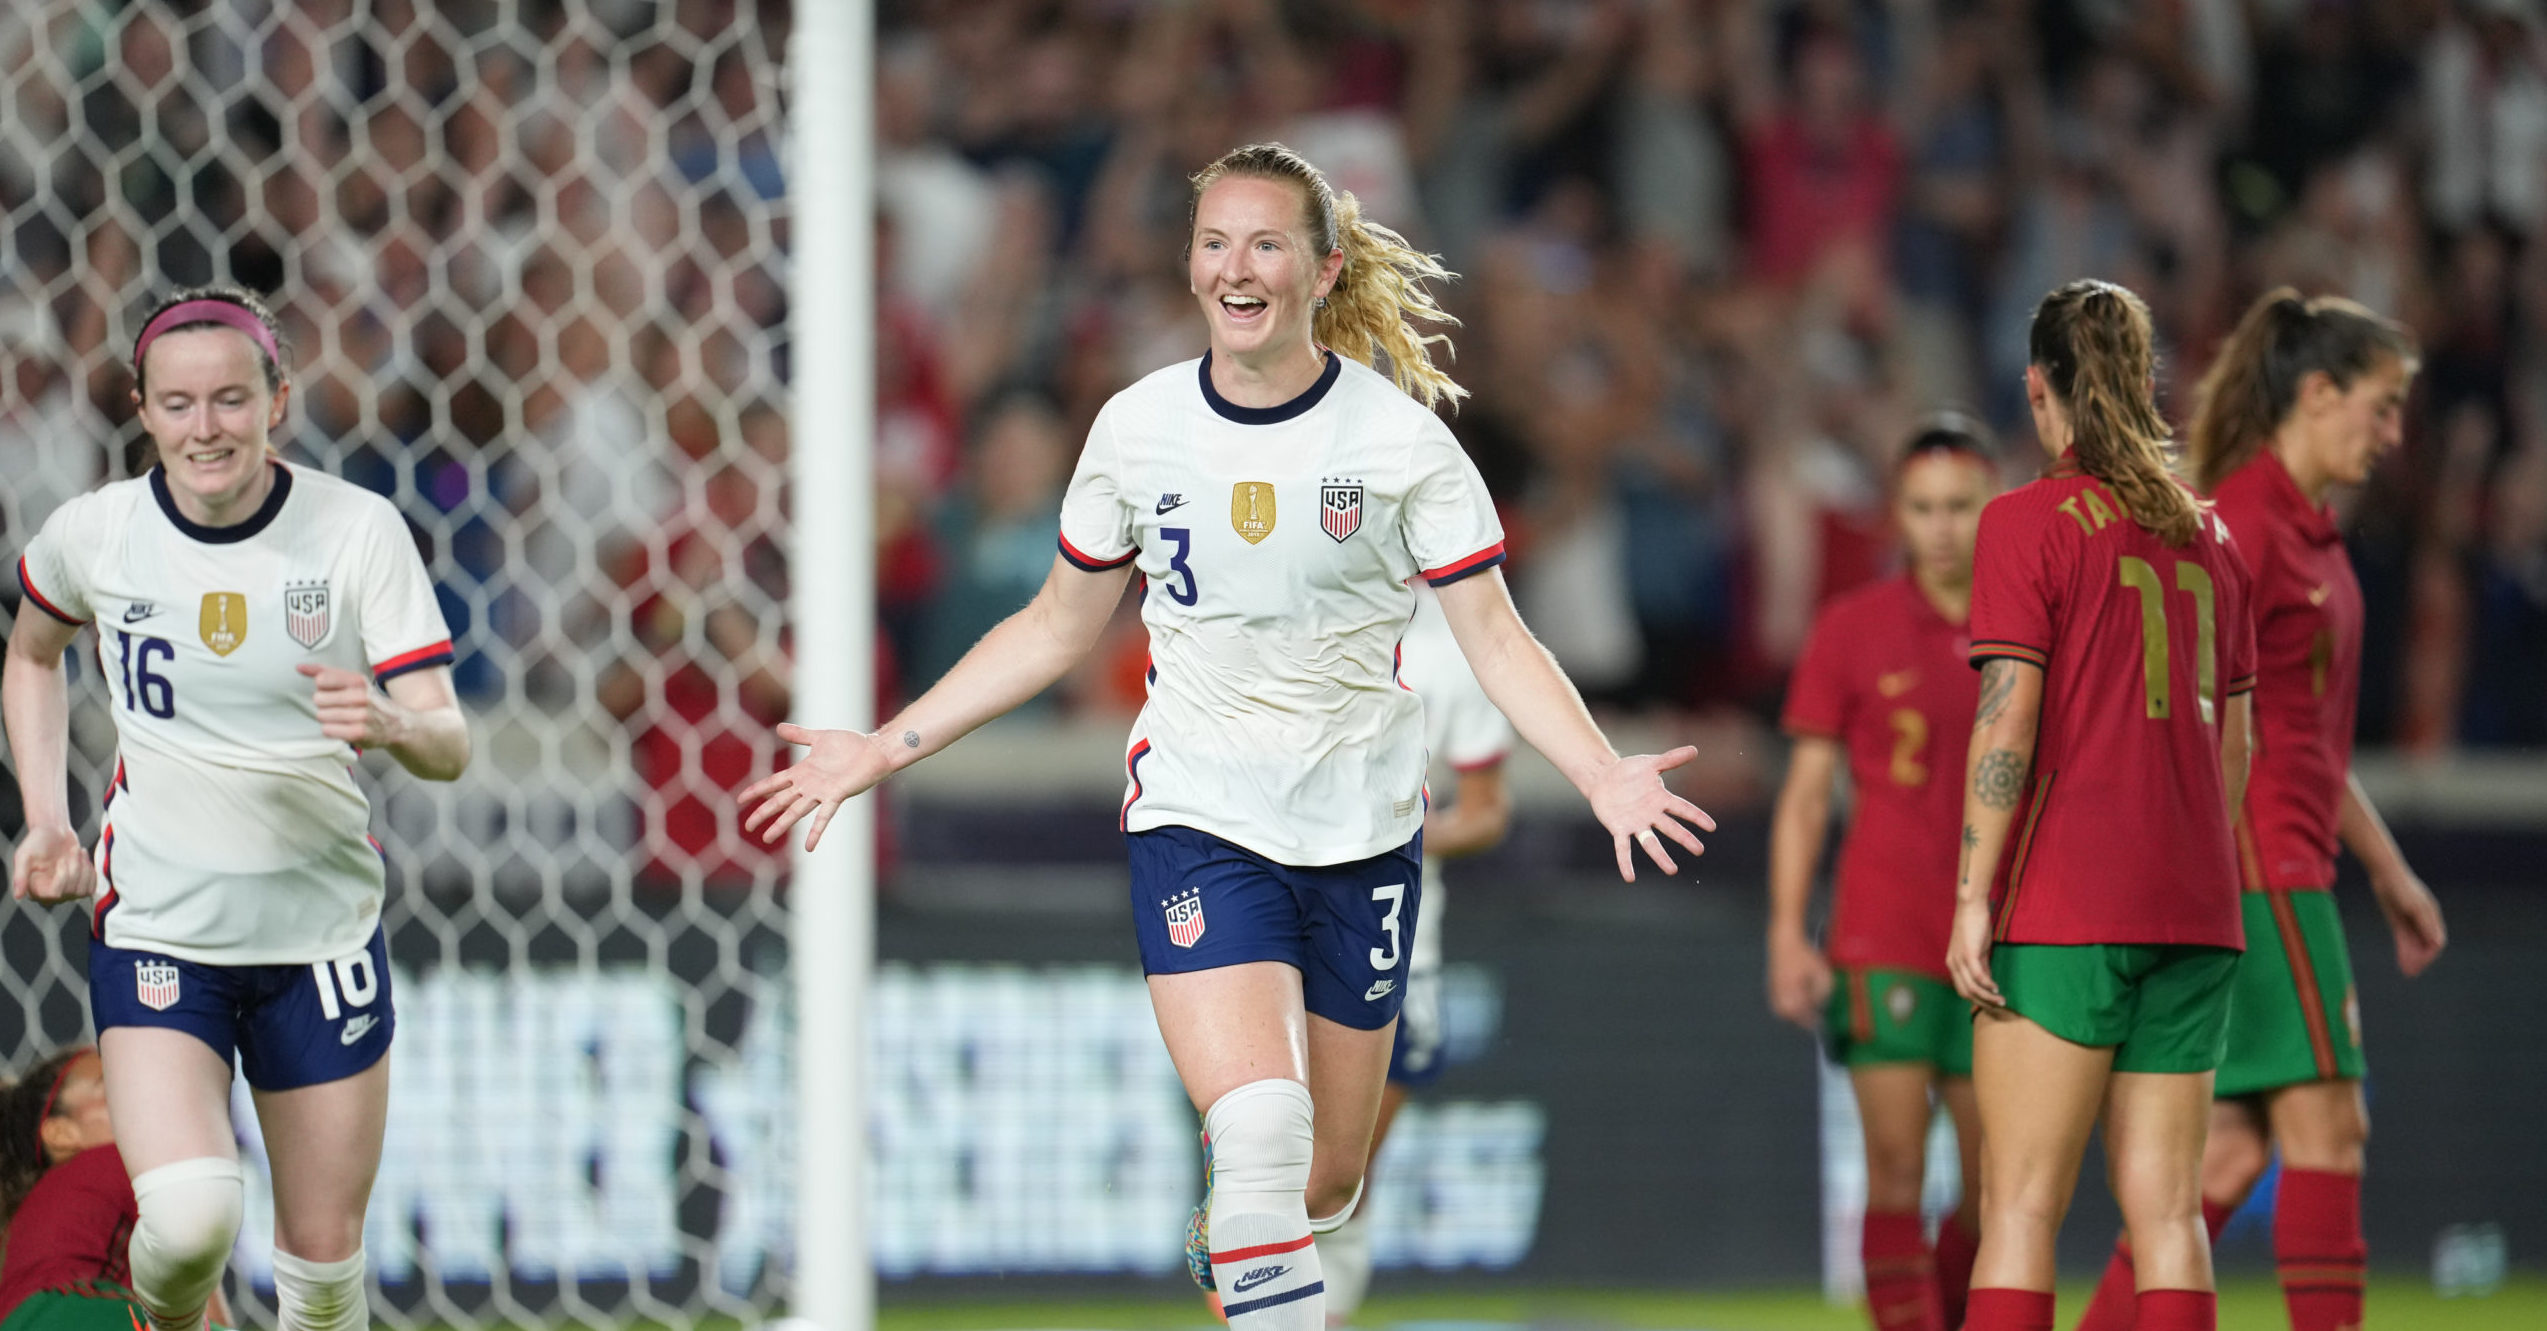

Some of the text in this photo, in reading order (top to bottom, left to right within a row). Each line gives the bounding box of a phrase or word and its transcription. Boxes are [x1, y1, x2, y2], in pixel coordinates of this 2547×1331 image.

[1160, 493, 1182, 506] NIKE
[1325, 490, 1359, 510] USA
[1243, 521, 1264, 529] FIFA
[1159, 527, 1198, 607] 3
[290, 593, 325, 614] USA
[2119, 556, 2216, 725] 11
[117, 630, 175, 719] 16
[1889, 709, 1928, 786] 2
[1168, 900, 1199, 922] USA
[1369, 883, 1405, 970] 3
[140, 970, 176, 984] USA
[1241, 1265, 1284, 1282] NIKE
